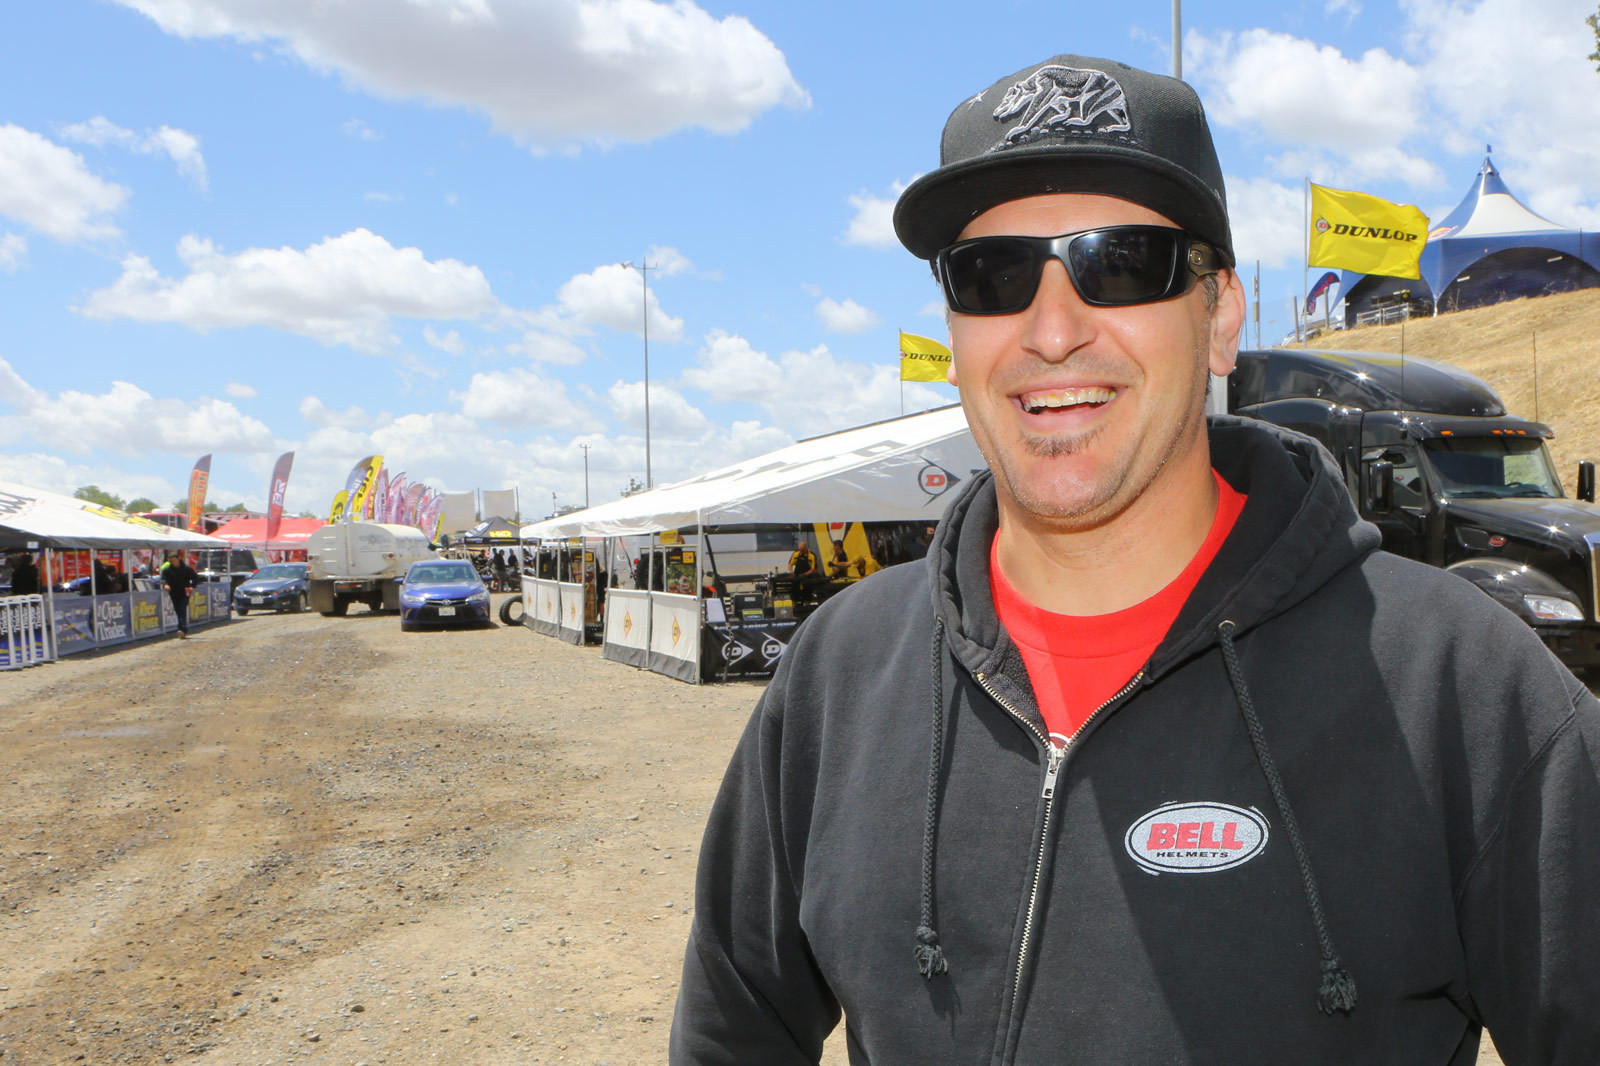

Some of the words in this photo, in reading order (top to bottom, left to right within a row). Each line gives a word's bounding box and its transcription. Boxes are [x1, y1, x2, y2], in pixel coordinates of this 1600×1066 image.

[1332, 223, 1418, 242] DUNLOP
[909, 352, 952, 362] DUNLO
[924, 473, 946, 487] D
[1147, 821, 1244, 851] BELL
